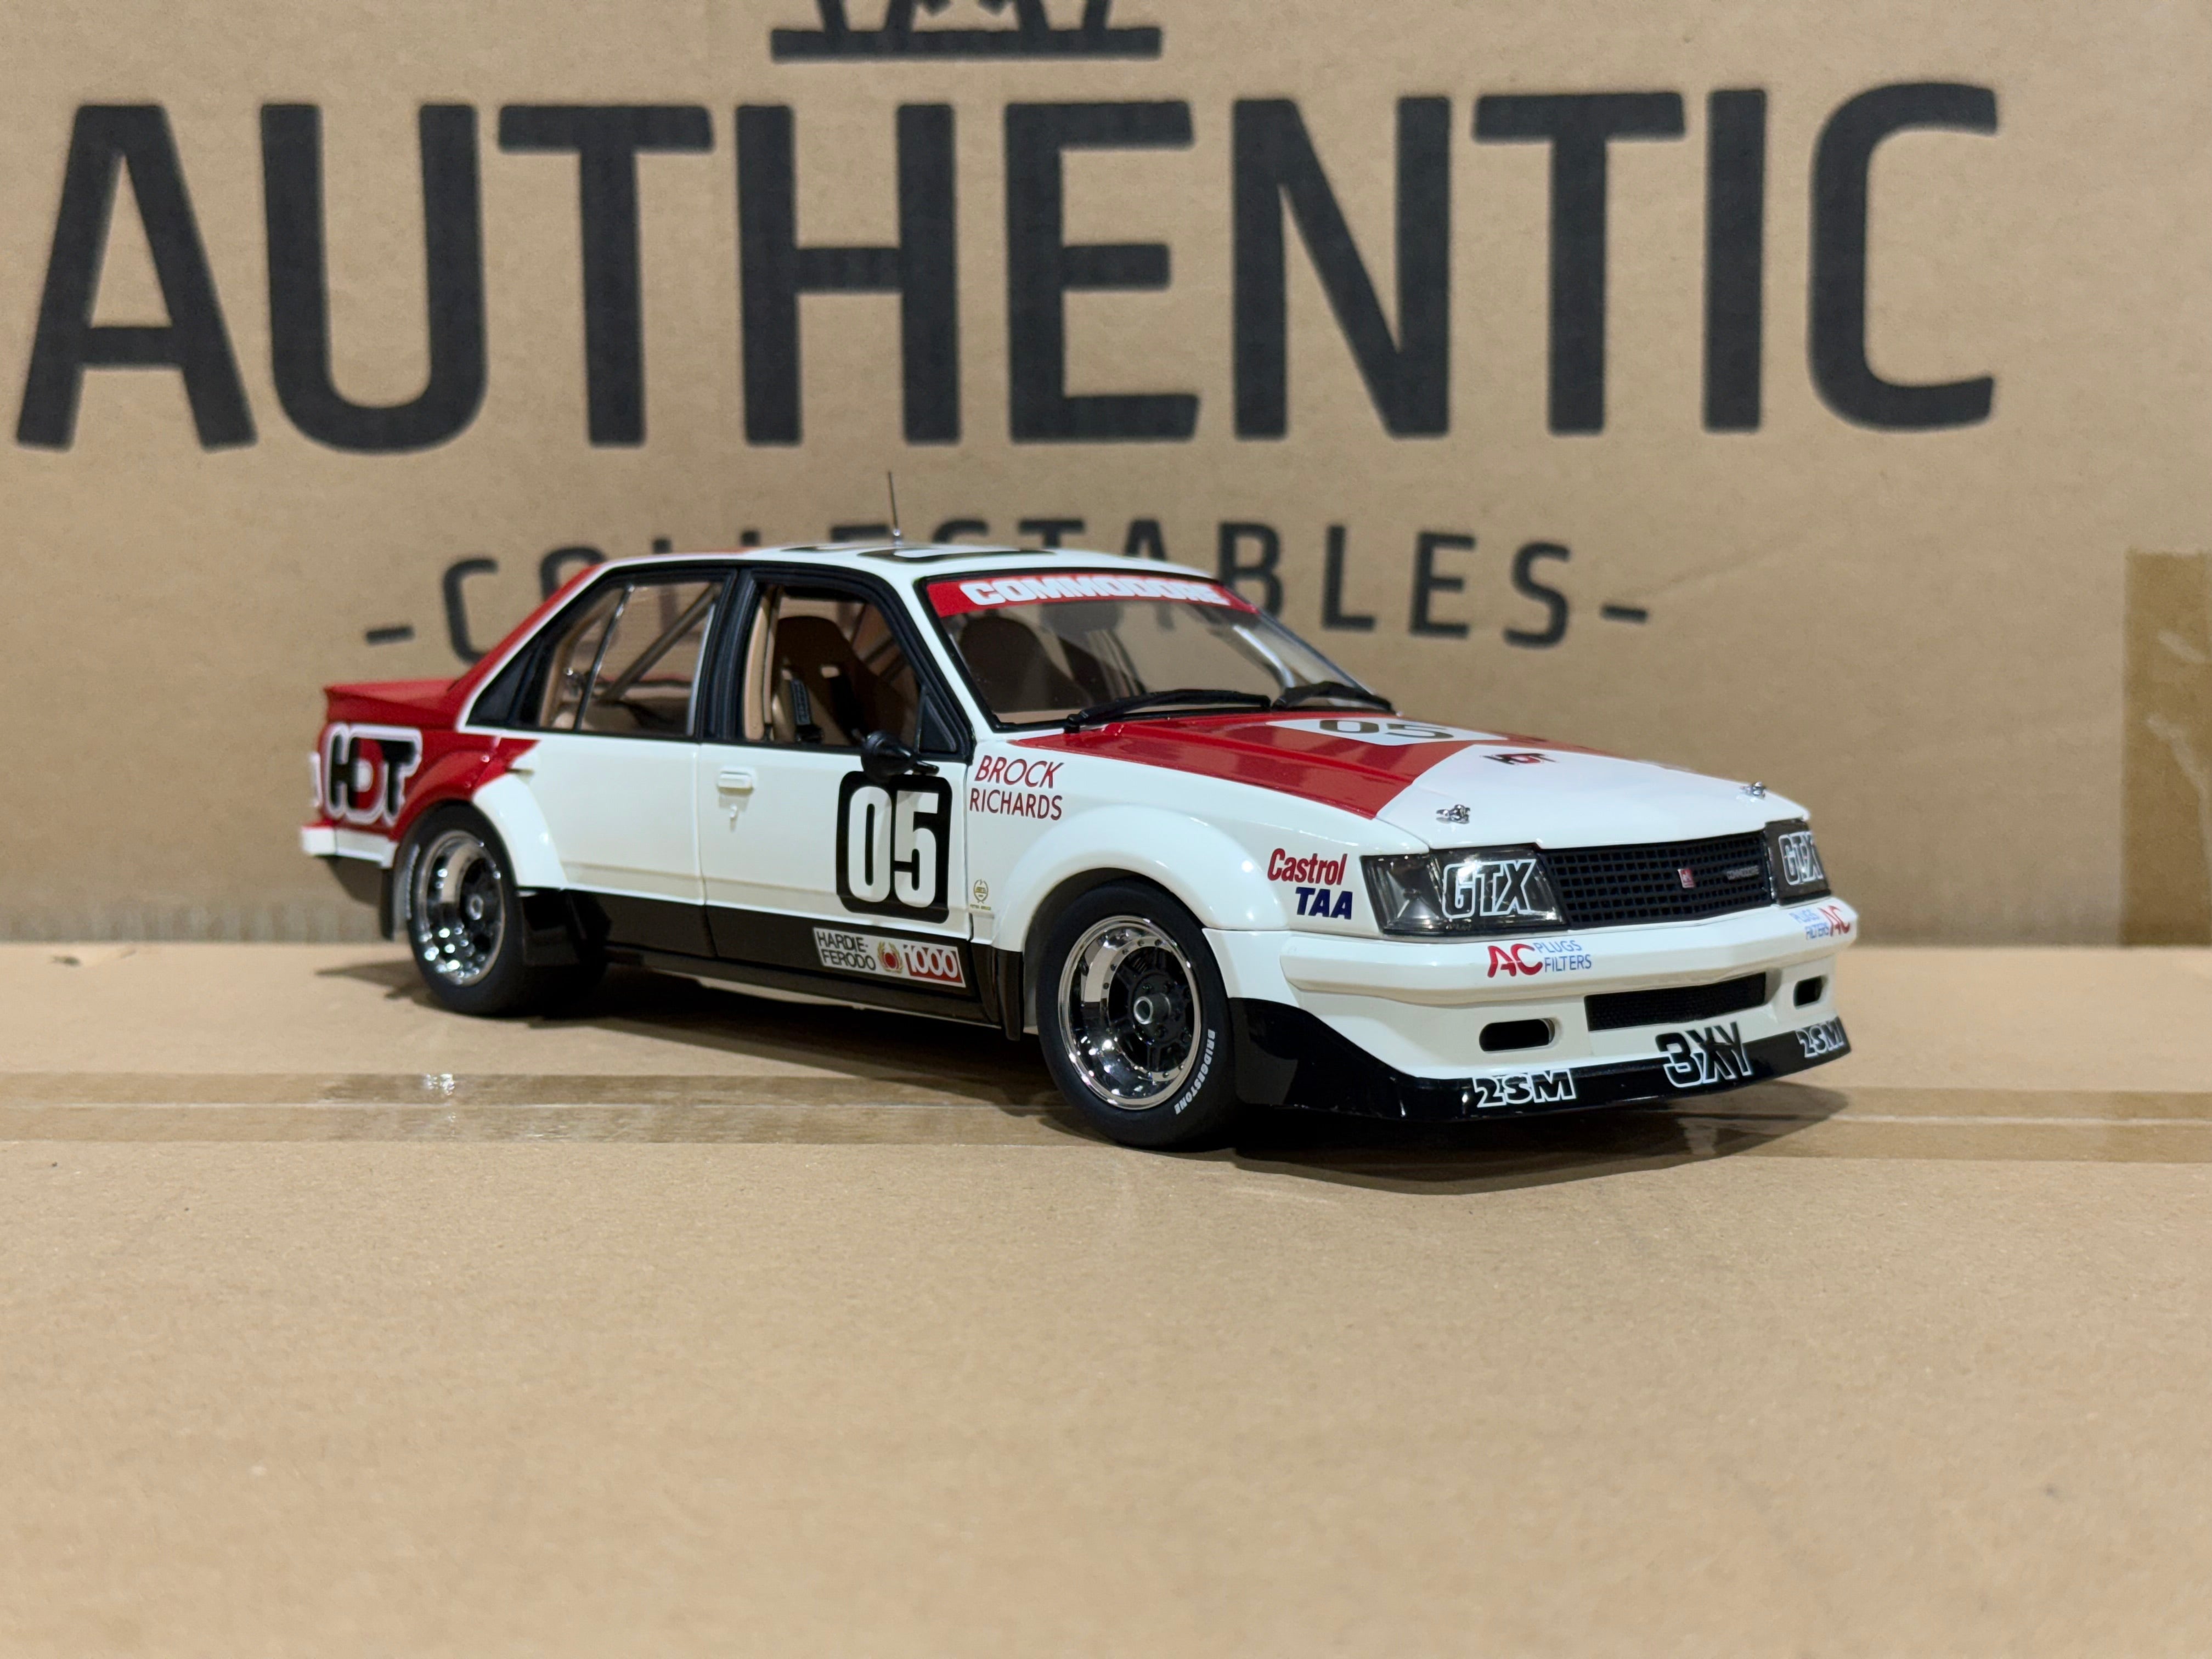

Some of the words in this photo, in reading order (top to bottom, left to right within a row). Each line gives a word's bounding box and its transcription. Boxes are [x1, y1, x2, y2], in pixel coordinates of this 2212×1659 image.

[14, 81, 2000, 455] AUTHENTIC
[959, 574, 1231, 606] COMMODORE
[1319, 719, 1455, 740] 05
[974, 754, 1065, 789] BROCK
[969, 787, 1063, 821] RICHARDS
[848, 785, 940, 909] 05
[1778, 831, 1824, 885] GTX
[1267, 848, 1348, 886] Castrol
[1295, 887, 1353, 921] TAA
[1442, 858, 1537, 920] GTX
[820, 948, 877, 972] FERODO
[905, 944, 959, 979] 1000
[1487, 943, 1543, 978] AC
[1533, 940, 1583, 953] PLUGS
[1544, 954, 1592, 973] FILTERS
[1655, 1021, 1753, 1088] 3XY
[1795, 1018, 1844, 1059] 2SM
[1173, 1028, 1216, 1115] BRIDGESTONE
[1472, 1068, 1577, 1109] 2SM
